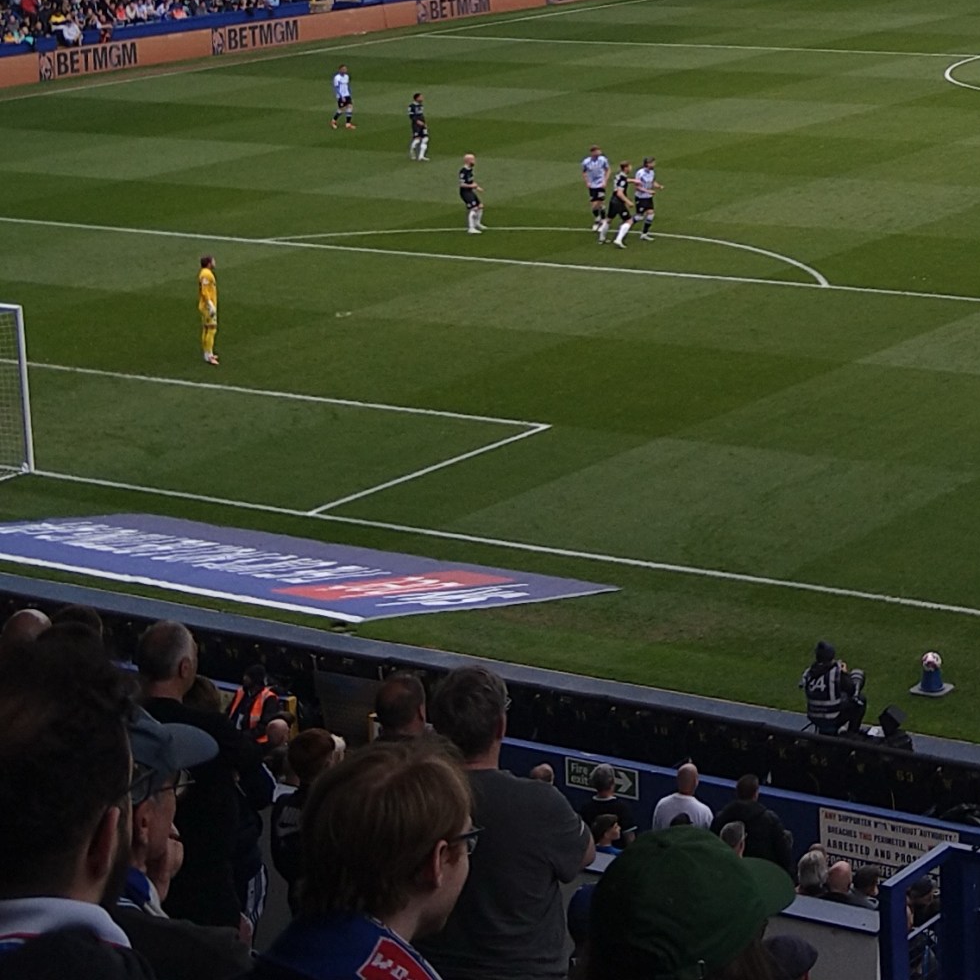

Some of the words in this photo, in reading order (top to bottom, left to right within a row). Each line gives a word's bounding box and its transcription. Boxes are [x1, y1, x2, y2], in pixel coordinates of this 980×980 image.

[228, 20, 298, 51] BETMGM
[56, 42, 137, 76] BETMGM
[570, 774, 589, 785] exit
[571, 762, 588, 775] Fire
[827, 825, 857, 839] BREACHES
[874, 834, 906, 848] PERIMETER
[838, 813, 872, 827] SUPPORTER
[890, 823, 918, 837] WITHOUT
[920, 828, 953, 841] AUTHORITY
[826, 838, 870, 856] ARRESTED
[874, 847, 891, 861] AND
